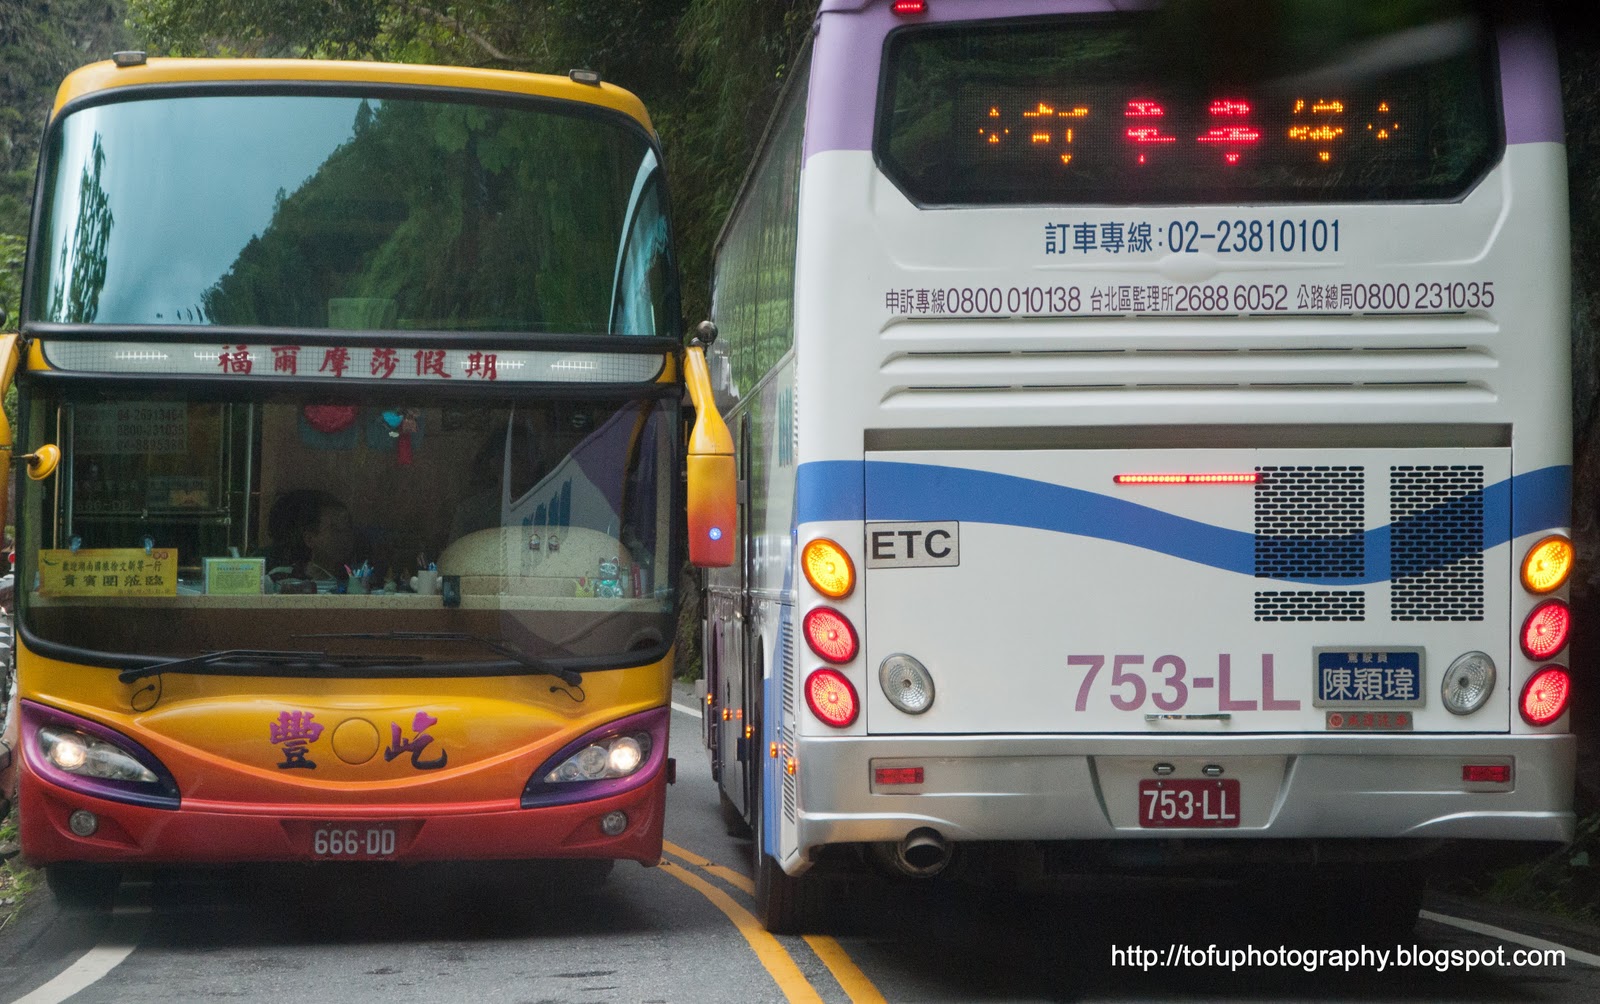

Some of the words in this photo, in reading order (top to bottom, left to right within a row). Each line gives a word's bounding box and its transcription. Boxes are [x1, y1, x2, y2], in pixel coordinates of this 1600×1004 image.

[1007, 286, 1081, 313] 010138
[1234, 285, 1288, 311] 6052
[1415, 282, 1495, 309] 231035
[218, 344, 498, 381] 福爾摩莎假期
[872, 529, 952, 560] ETC
[1067, 653, 1301, 712] 753-LL
[1322, 667, 1415, 700] 陳穎瑋
[1143, 790, 1236, 821] 753-LL
[314, 829, 396, 855] 666-DD
